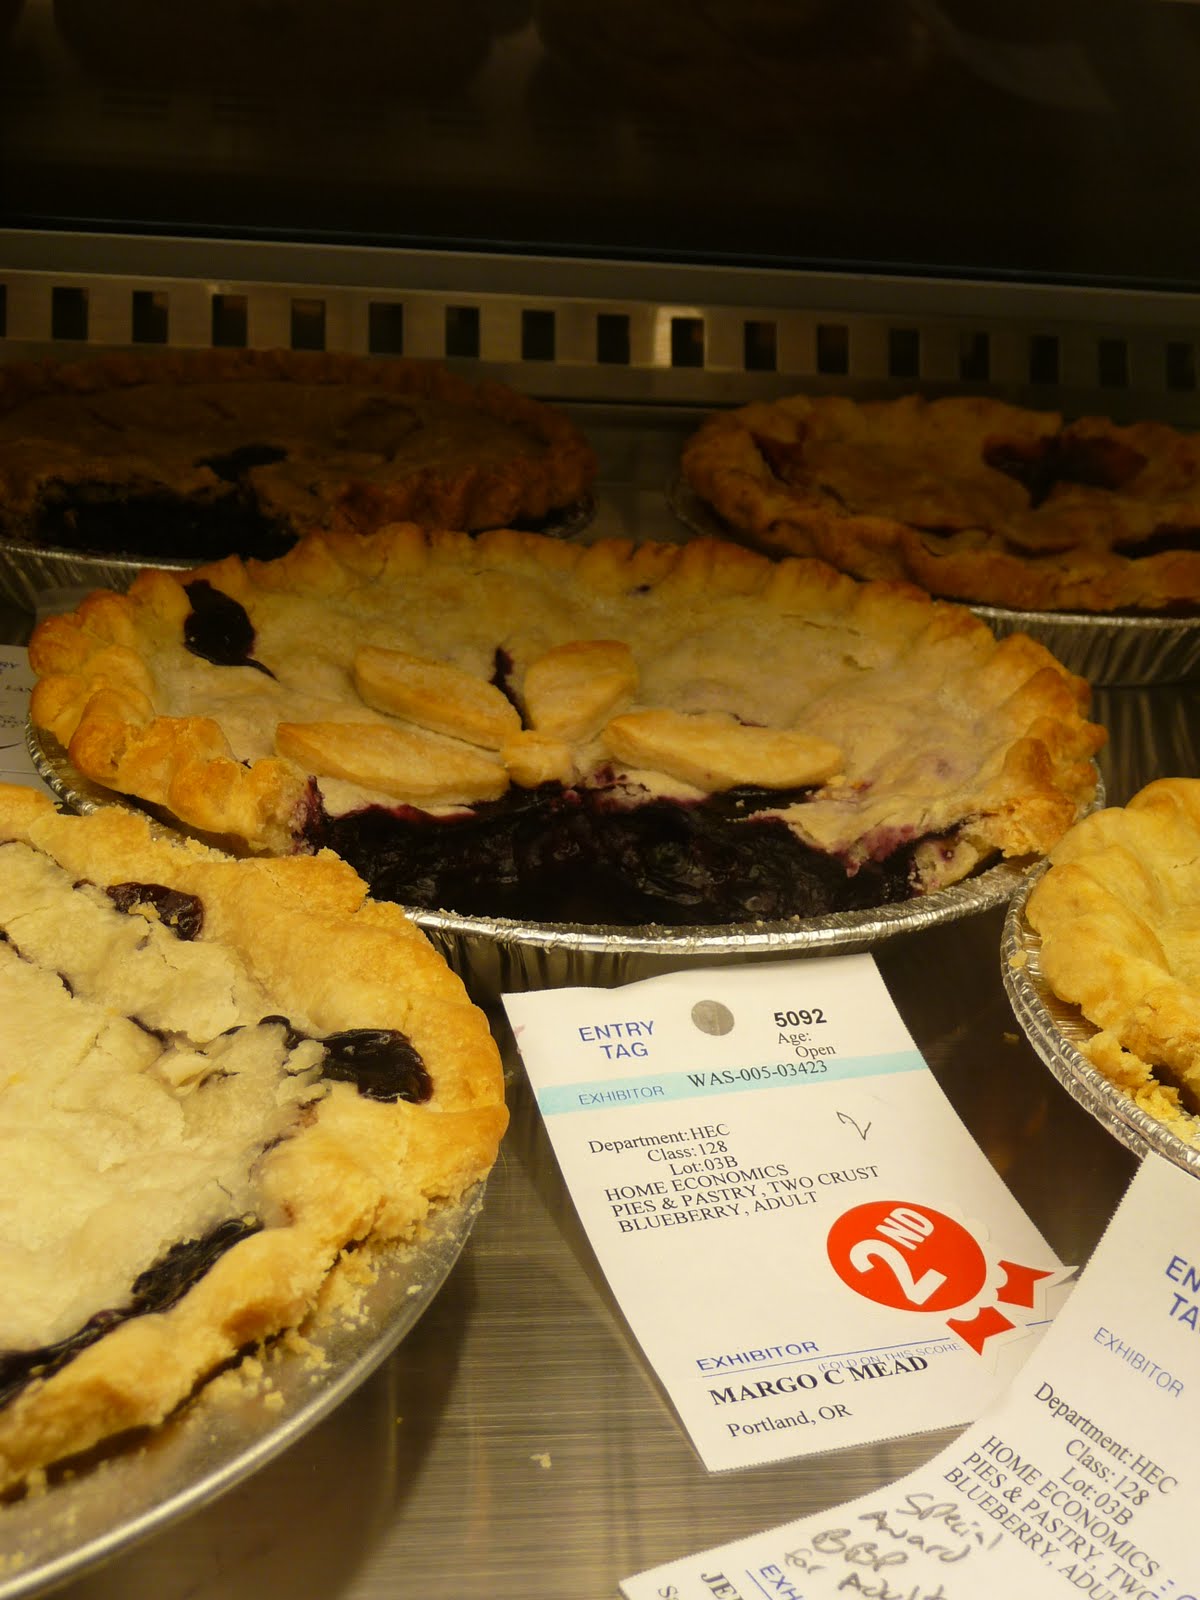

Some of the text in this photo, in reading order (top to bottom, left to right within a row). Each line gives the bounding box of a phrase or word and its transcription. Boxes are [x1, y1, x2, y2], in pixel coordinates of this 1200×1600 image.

[578, 1020, 654, 1041] ENTRY
[774, 1008, 827, 1027] 5092
[600, 1042, 648, 1059] TAG
[778, 1032, 812, 1046] Age:
[795, 1045, 837, 1060] Open
[687, 1060, 828, 1088] WAS-005-03423
[578, 1085, 665, 1105] EXHIBITOR
[604, 1163, 789, 1201] HOME ECONOMICS
[612, 1199, 657, 1217] PIES
[662, 1197, 678, 1210] &
[767, 1175, 815, 1193] TWO
[818, 1165, 880, 1186] CRUST
[754, 1191, 819, 1211] ADULT
[1169, 1292, 1200, 1334] TA
[696, 1341, 819, 1372] EXHIBITOR
[915, 1343, 961, 1356] SCORE
[1093, 1326, 1185, 1397] EXHIBITOR
[708, 1355, 928, 1406] MARGO C MEAD
[726, 1404, 853, 1437] Portland, OR
[962, 1452, 1004, 1490] PIES
[1003, 1485, 1023, 1504] &
[981, 1436, 1160, 1577] HOME ECONOMICS
